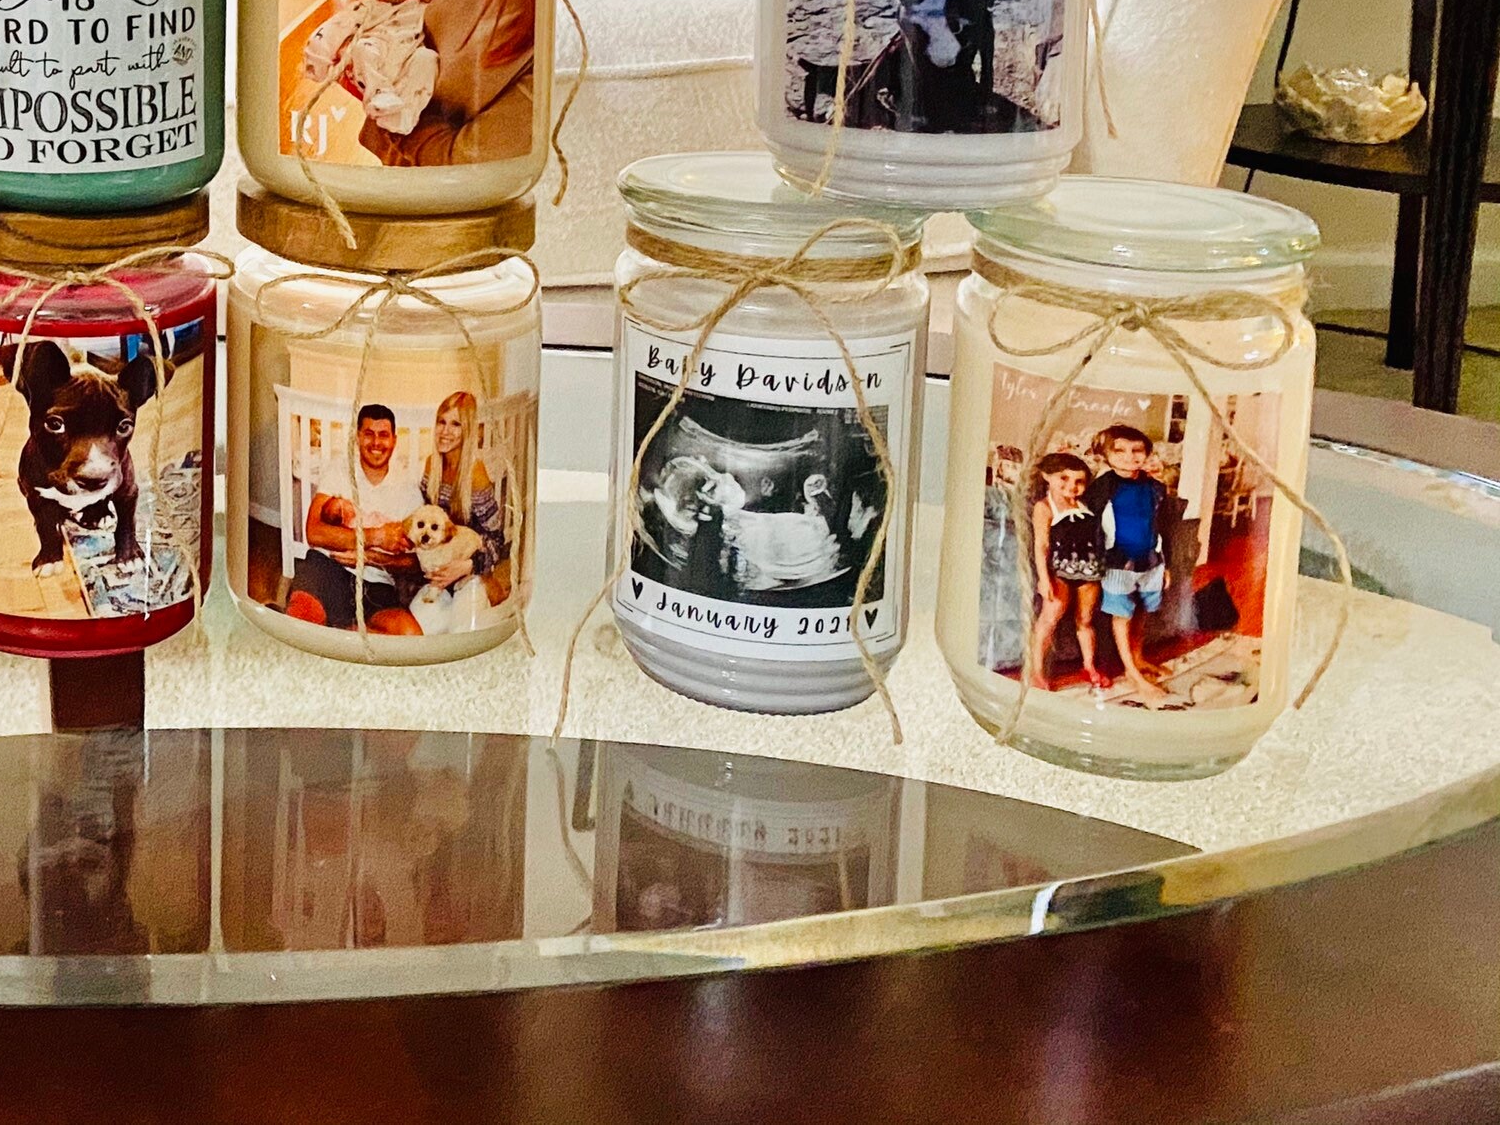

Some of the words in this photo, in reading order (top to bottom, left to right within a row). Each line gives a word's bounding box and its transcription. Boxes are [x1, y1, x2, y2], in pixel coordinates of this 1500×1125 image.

[67, 17, 109, 45] TO
[126, 6, 196, 42] FIND
[35, 52, 63, 78] to
[69, 50, 120, 91] part
[128, 42, 170, 72] with
[27, 120, 198, 165] FORGET
[647, 344, 717, 387] Bay
[736, 363, 882, 395] Davidsn
[656, 592, 778, 639] January
[797, 616, 851, 635] 2021
